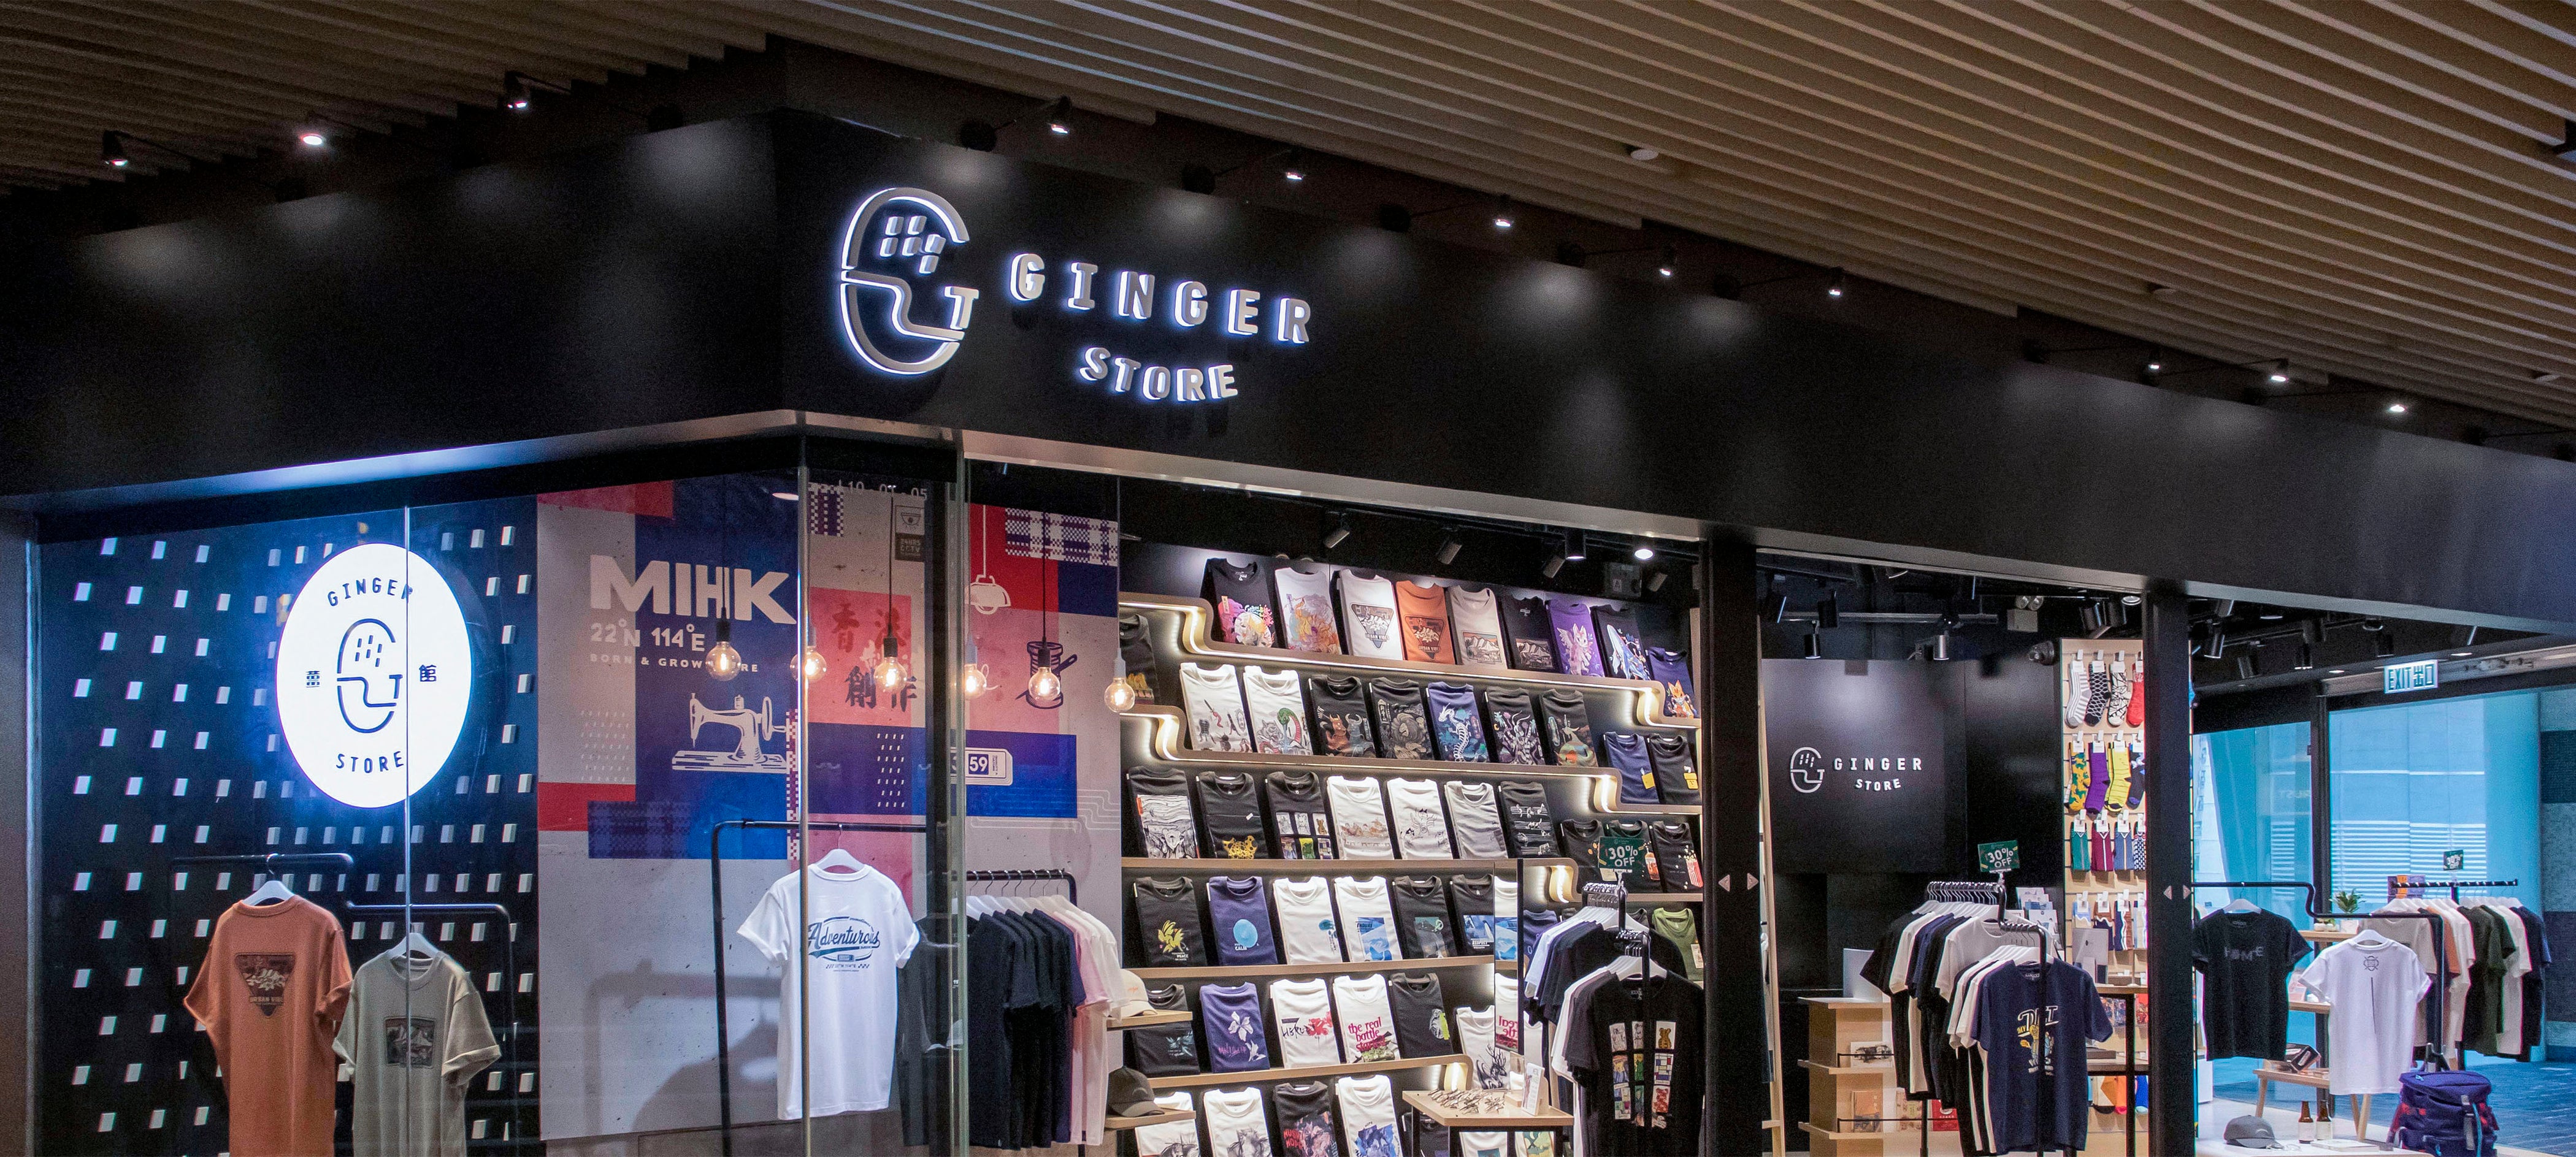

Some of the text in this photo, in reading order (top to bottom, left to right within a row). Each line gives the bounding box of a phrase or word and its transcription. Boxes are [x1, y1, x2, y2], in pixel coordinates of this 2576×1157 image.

[1010, 252, 1311, 344] GINGER
[1079, 346, 1239, 402] STORE
[590, 554, 797, 625] MIHK
[589, 654, 632, 664] BORN
[641, 657, 650, 665] &
[658, 658, 705, 668] GROW
[419, 665, 437, 682] 館
[2388, 666, 2412, 691] EXIT
[2413, 663, 2434, 687] 出口
[335, 750, 405, 773] STORE
[969, 756, 988, 772] 59
[1833, 757, 1923, 771] GINGER
[1855, 778, 1901, 791] STORE
[1608, 845, 1638, 860] 30%
[1987, 847, 2014, 863] 30%
[1614, 857, 1636, 867] OFF
[1994, 857, 2012, 868] OFF
[1348, 1017, 1382, 1034] the real
[1356, 1029, 1380, 1042] battle
